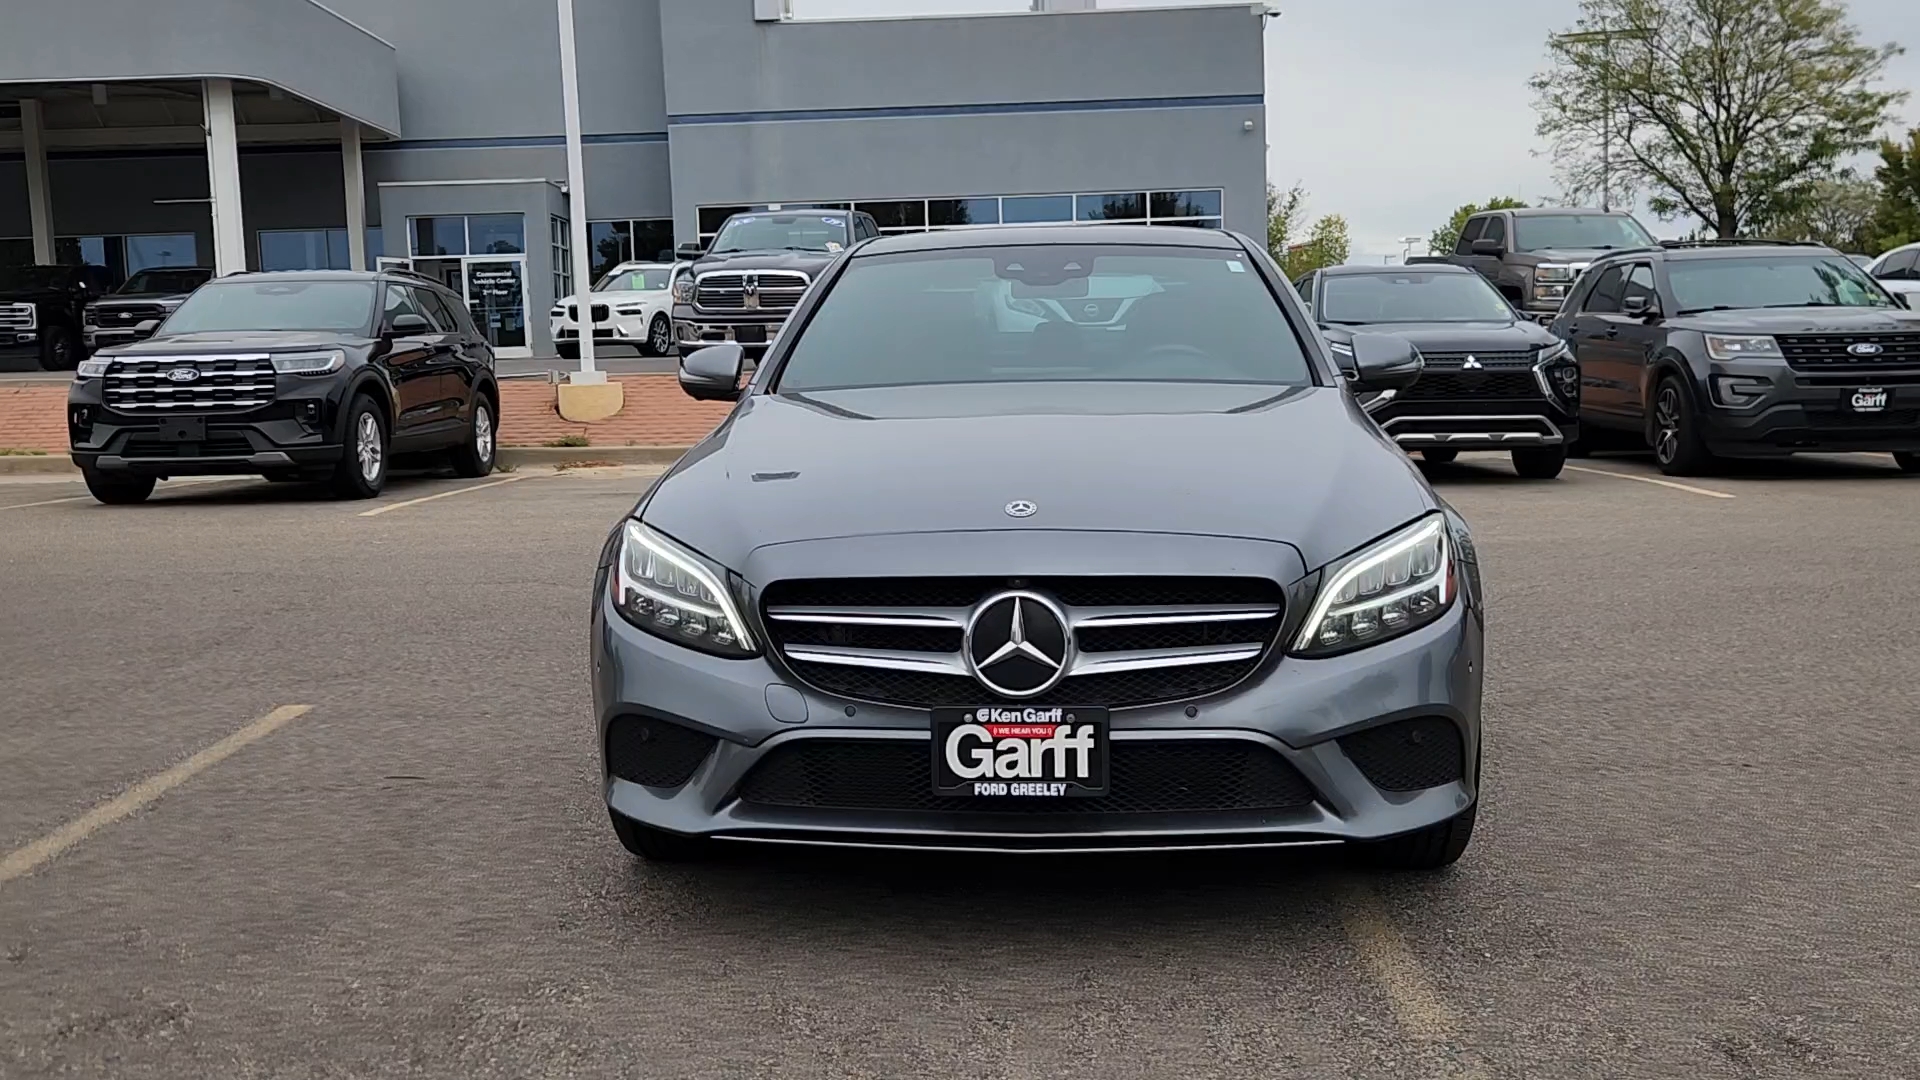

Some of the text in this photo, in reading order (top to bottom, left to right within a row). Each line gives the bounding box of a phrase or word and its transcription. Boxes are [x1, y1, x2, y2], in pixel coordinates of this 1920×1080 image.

[1852, 393, 1887, 407] Garff
[991, 708, 1062, 722] Ken Garff
[946, 724, 1095, 778] Garff
[974, 783, 1066, 796] FORD GREELEY
